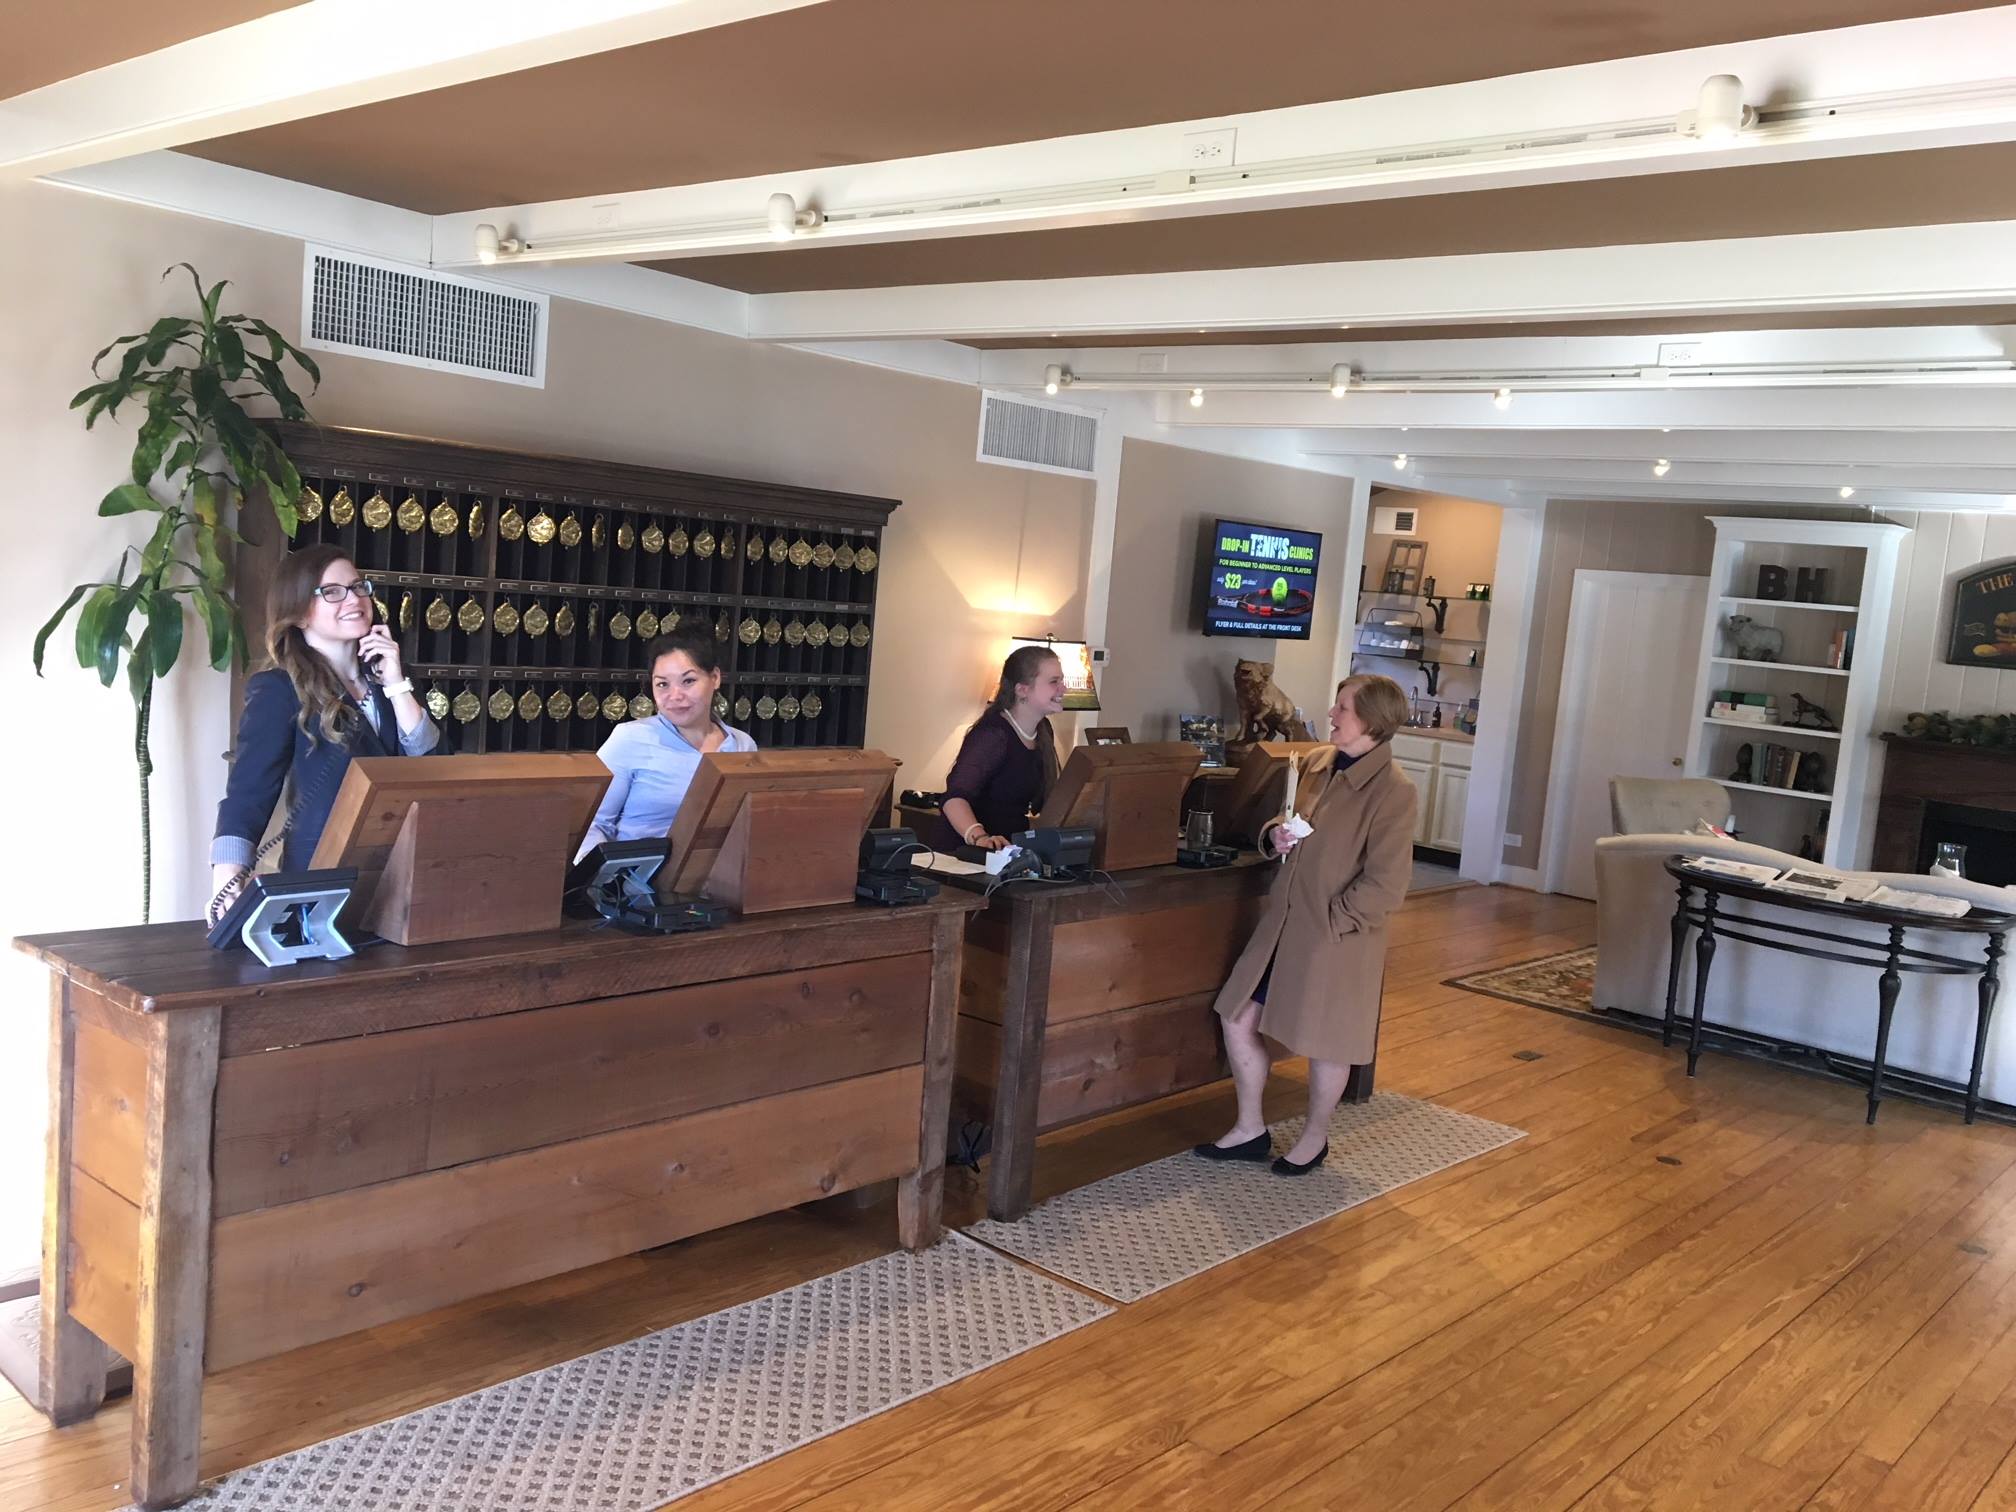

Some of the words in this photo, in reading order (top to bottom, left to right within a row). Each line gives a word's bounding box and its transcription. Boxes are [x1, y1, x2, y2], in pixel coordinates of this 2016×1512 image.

[1221, 537, 1249, 552] DROP-IN
[1251, 534, 1289, 560] TENNIS
[1289, 546, 1313, 560] CLINICS
[1258, 562, 1281, 571] ADVANCED
[1294, 566, 1312, 574] PLAYERS
[1225, 573, 1241, 589] $23
[1977, 573, 2014, 593] THE
[1215, 620, 1230, 628] FLYER
